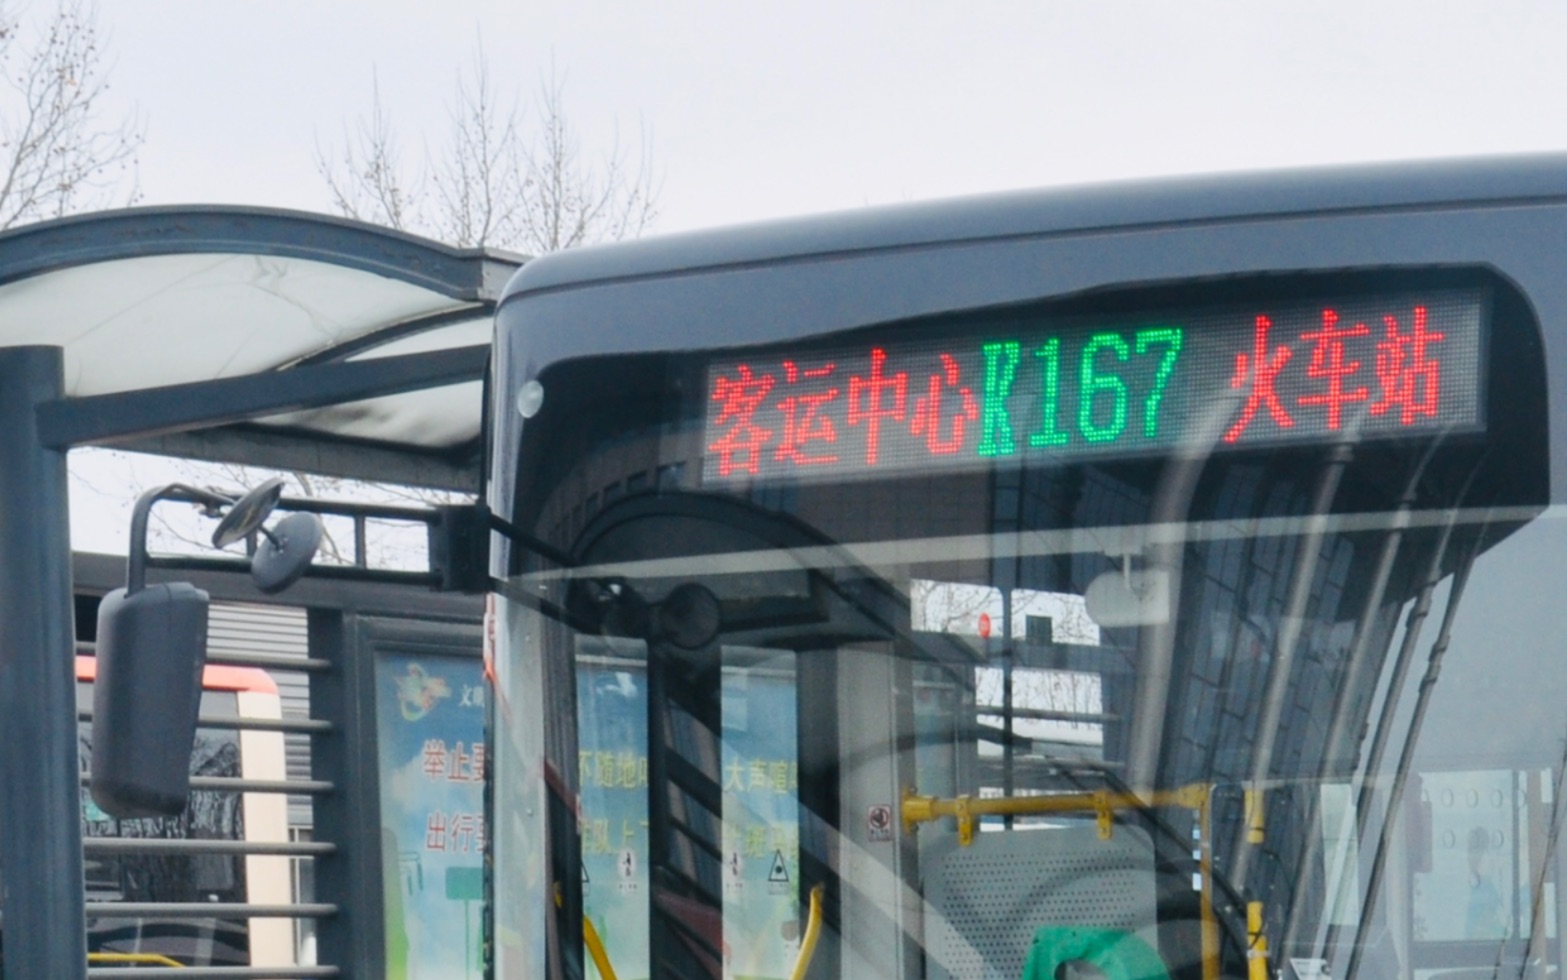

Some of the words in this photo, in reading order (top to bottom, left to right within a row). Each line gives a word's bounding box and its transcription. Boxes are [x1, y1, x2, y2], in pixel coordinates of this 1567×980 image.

[708, 346, 979, 477] 客运中心
[977, 327, 1184, 458] K167
[1223, 306, 1445, 444] 火车站
